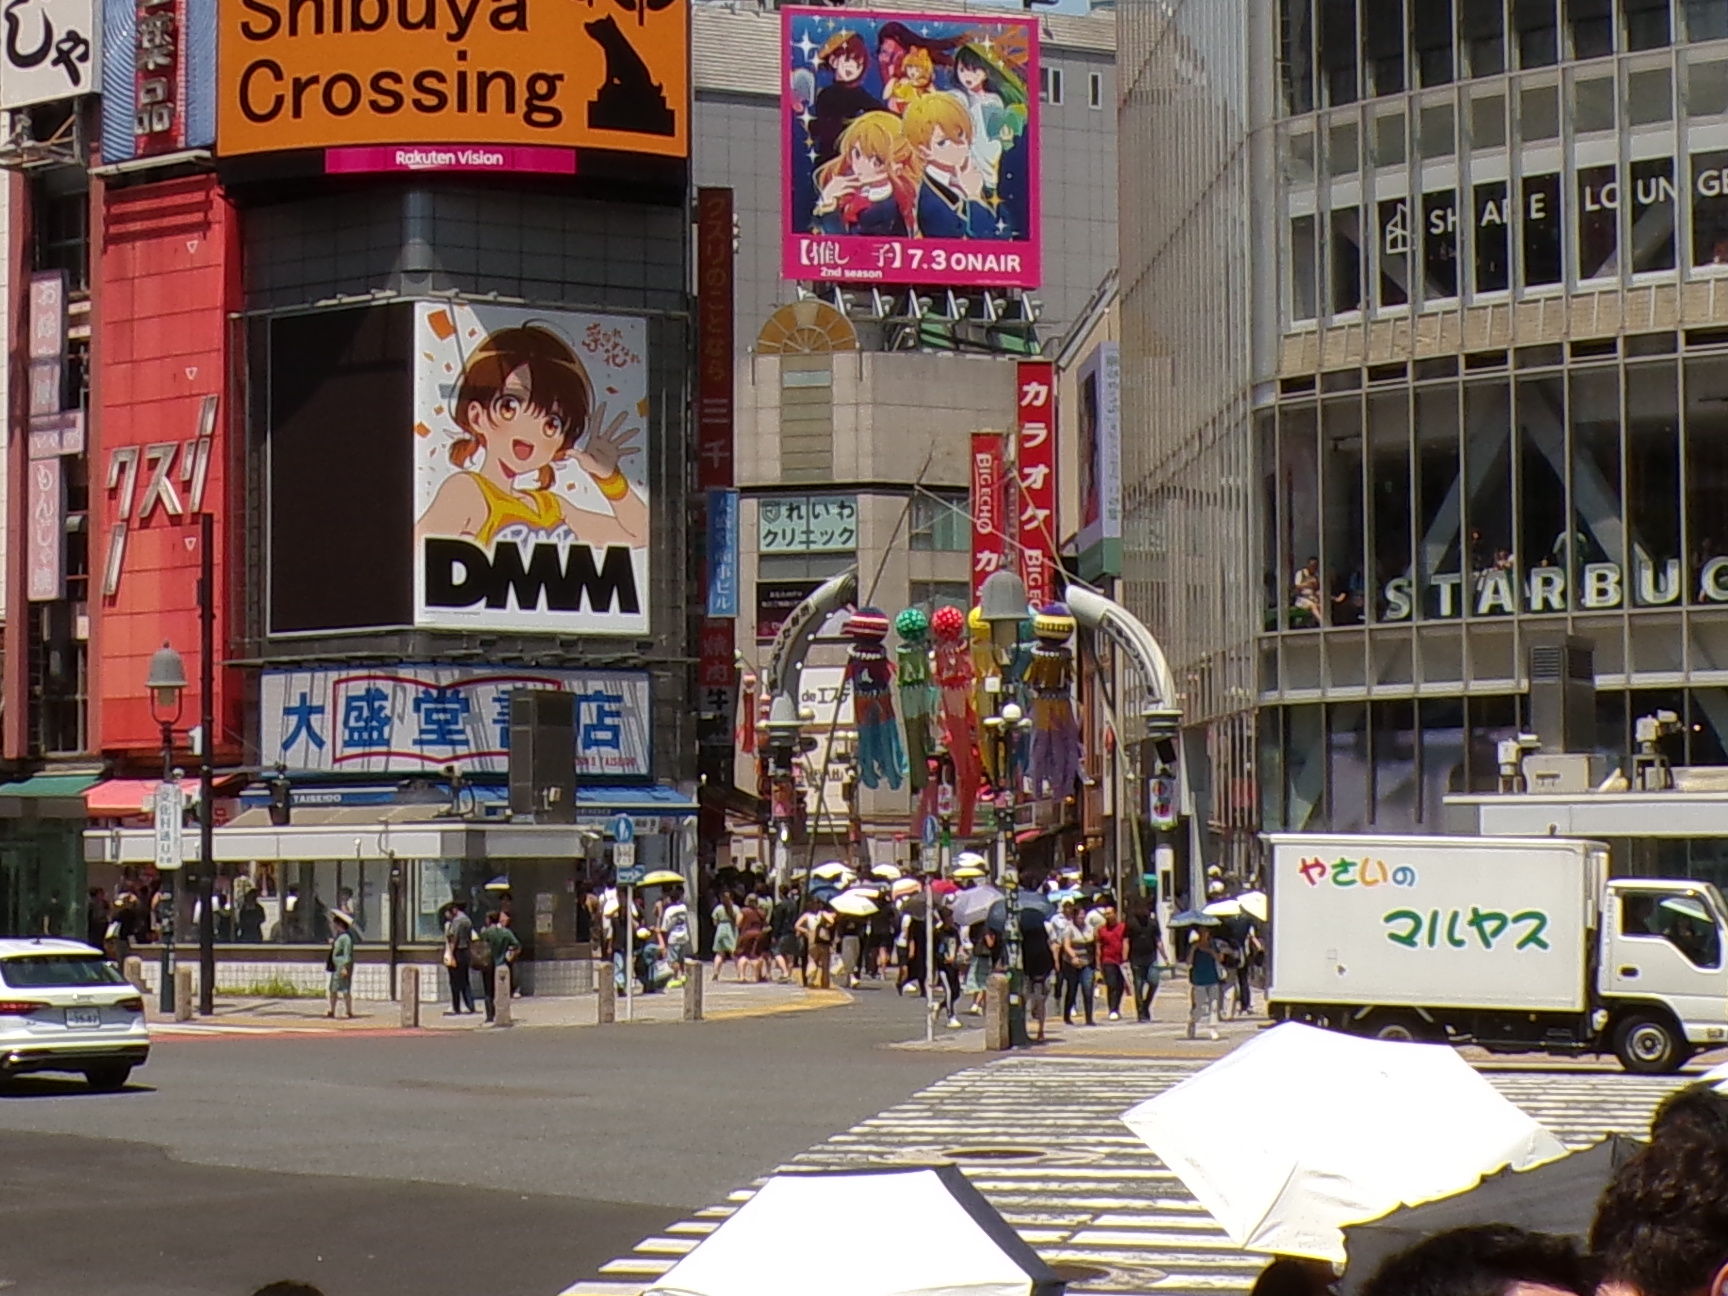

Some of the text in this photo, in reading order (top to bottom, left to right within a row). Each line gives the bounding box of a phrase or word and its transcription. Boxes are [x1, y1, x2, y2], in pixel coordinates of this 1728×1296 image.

[237, 49, 565, 129] Crossing
[395, 149, 505, 167] Rakuten Vision
[820, 267, 883, 280] 2nd season
[907, 248, 948, 270] 7.3
[951, 253, 1022, 273] ONAIR
[1020, 380, 1051, 531] カラオケ
[785, 500, 856, 522] れいわ
[975, 452, 993, 535] BIG ECHO
[762, 527, 856, 549] クリニック
[425, 537, 641, 616] DMM
[1024, 547, 1043, 587] BIG
[1297, 855, 1418, 889] やさいの
[1381, 905, 1552, 953] マルヤス
